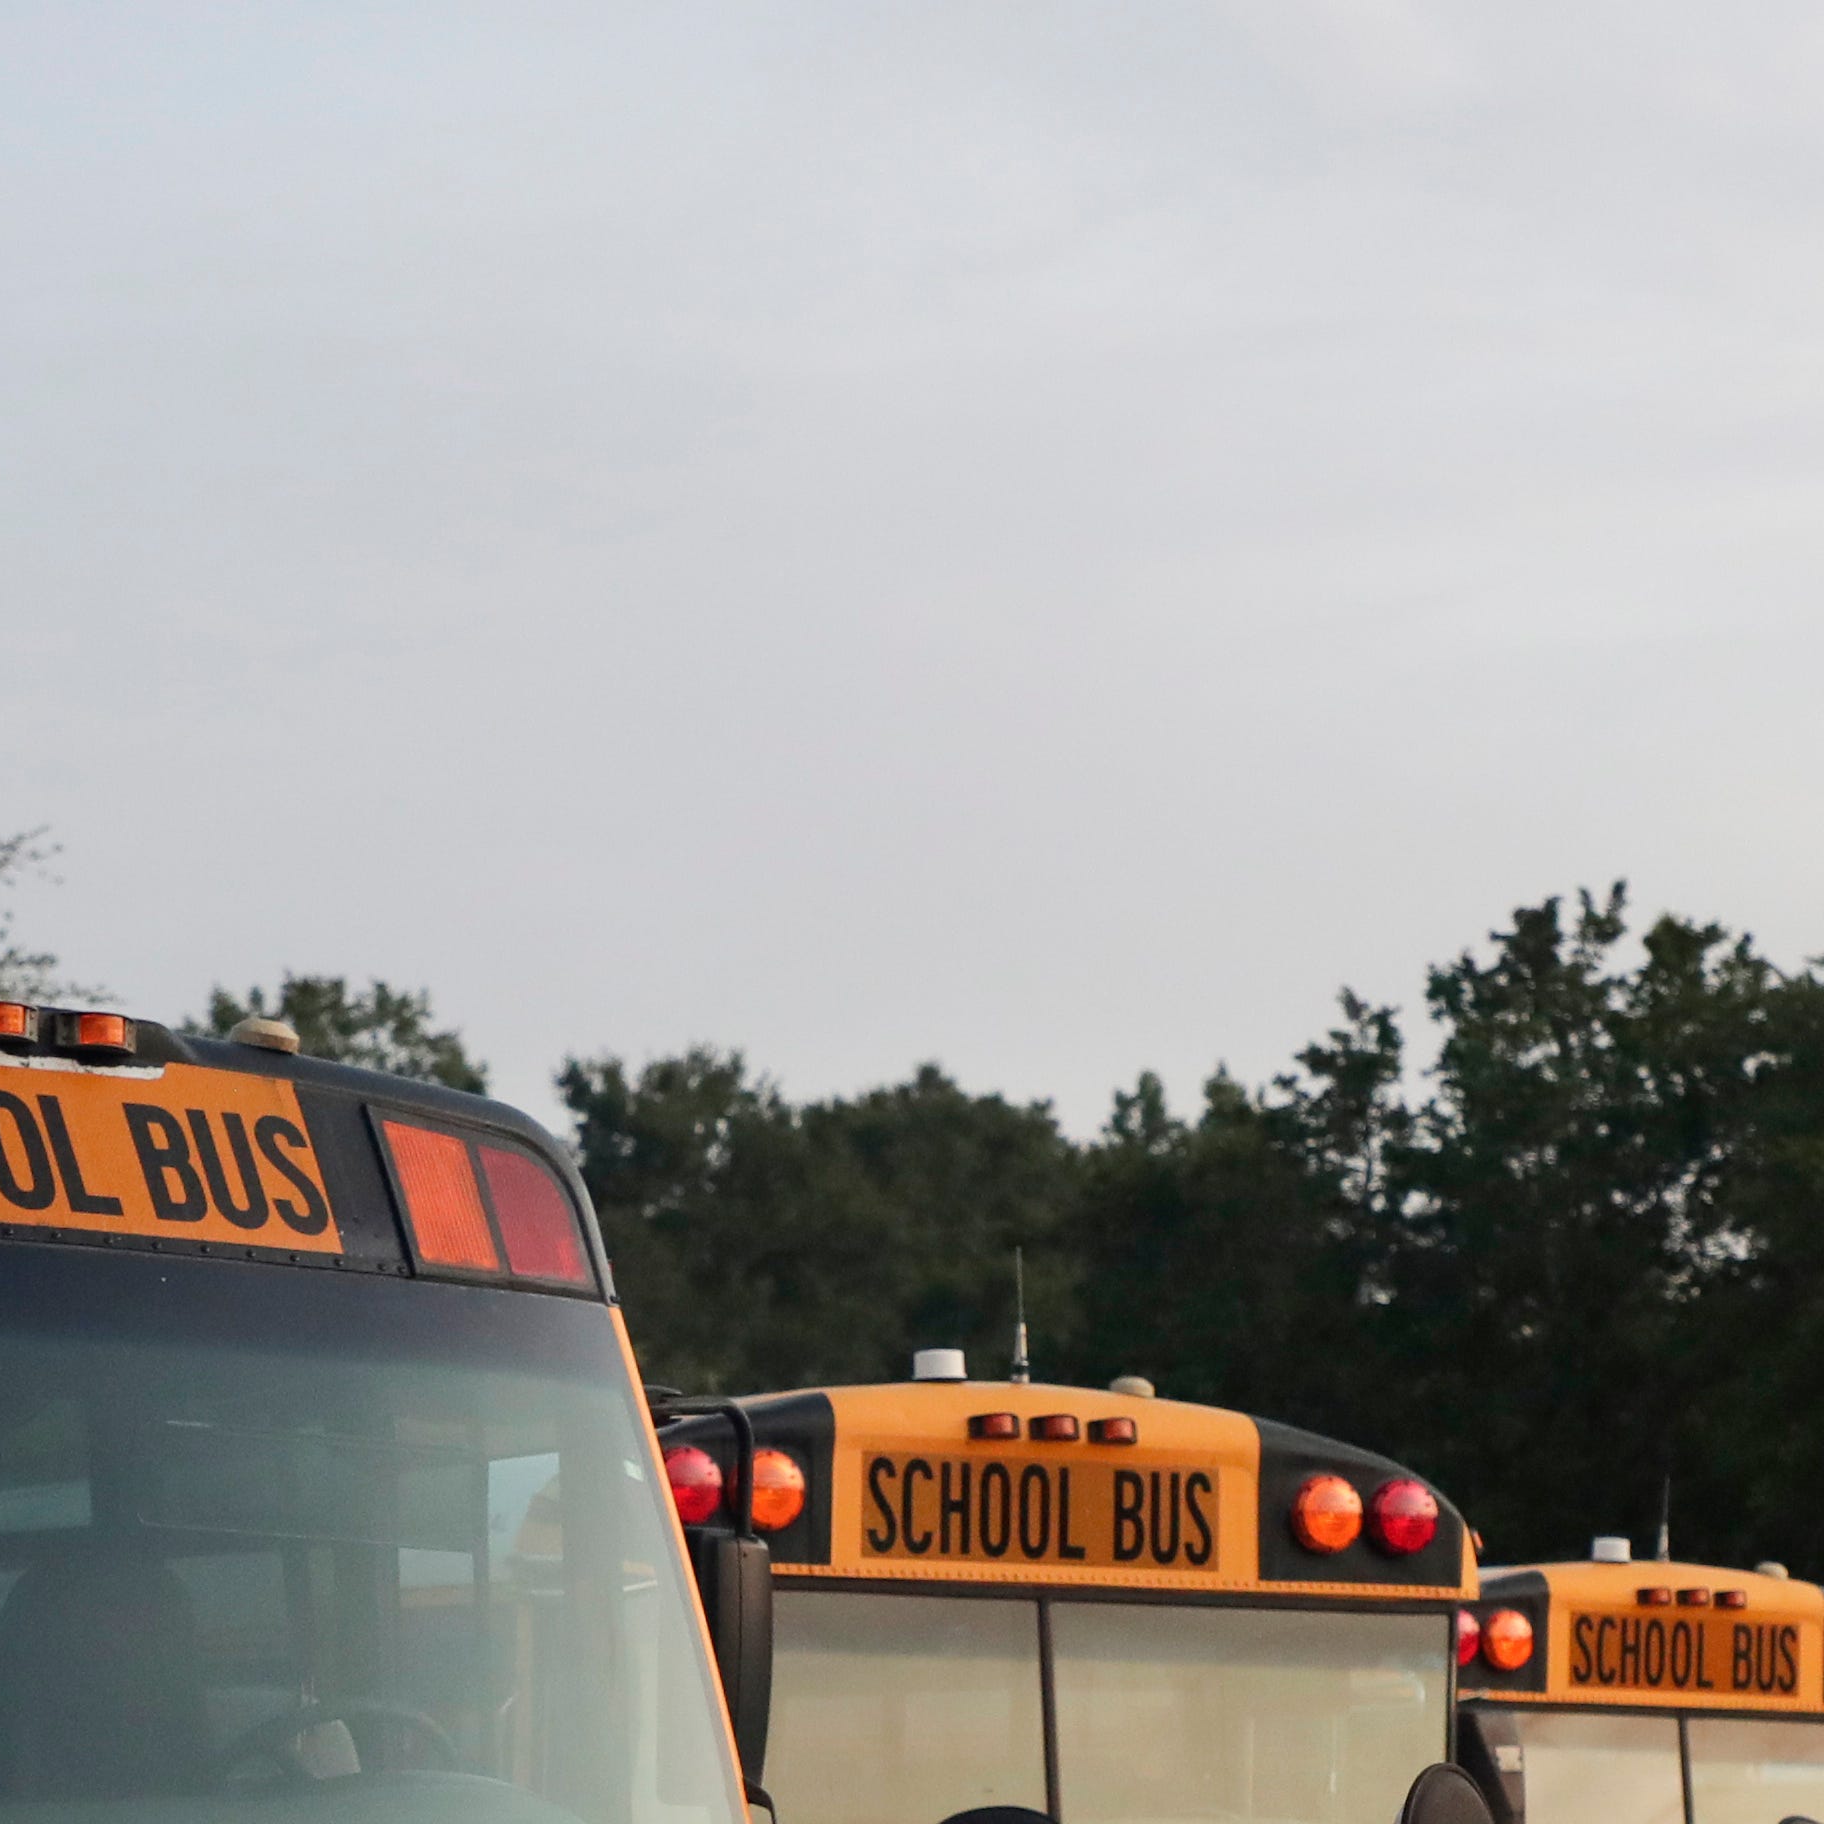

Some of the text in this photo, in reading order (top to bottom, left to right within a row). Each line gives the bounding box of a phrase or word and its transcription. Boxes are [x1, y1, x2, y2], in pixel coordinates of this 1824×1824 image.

[124, 1102, 329, 1236] BUS
[867, 1457, 1213, 1566] SCHOOL BUS
[1573, 1614, 1797, 1692] SCHOOL BUS
